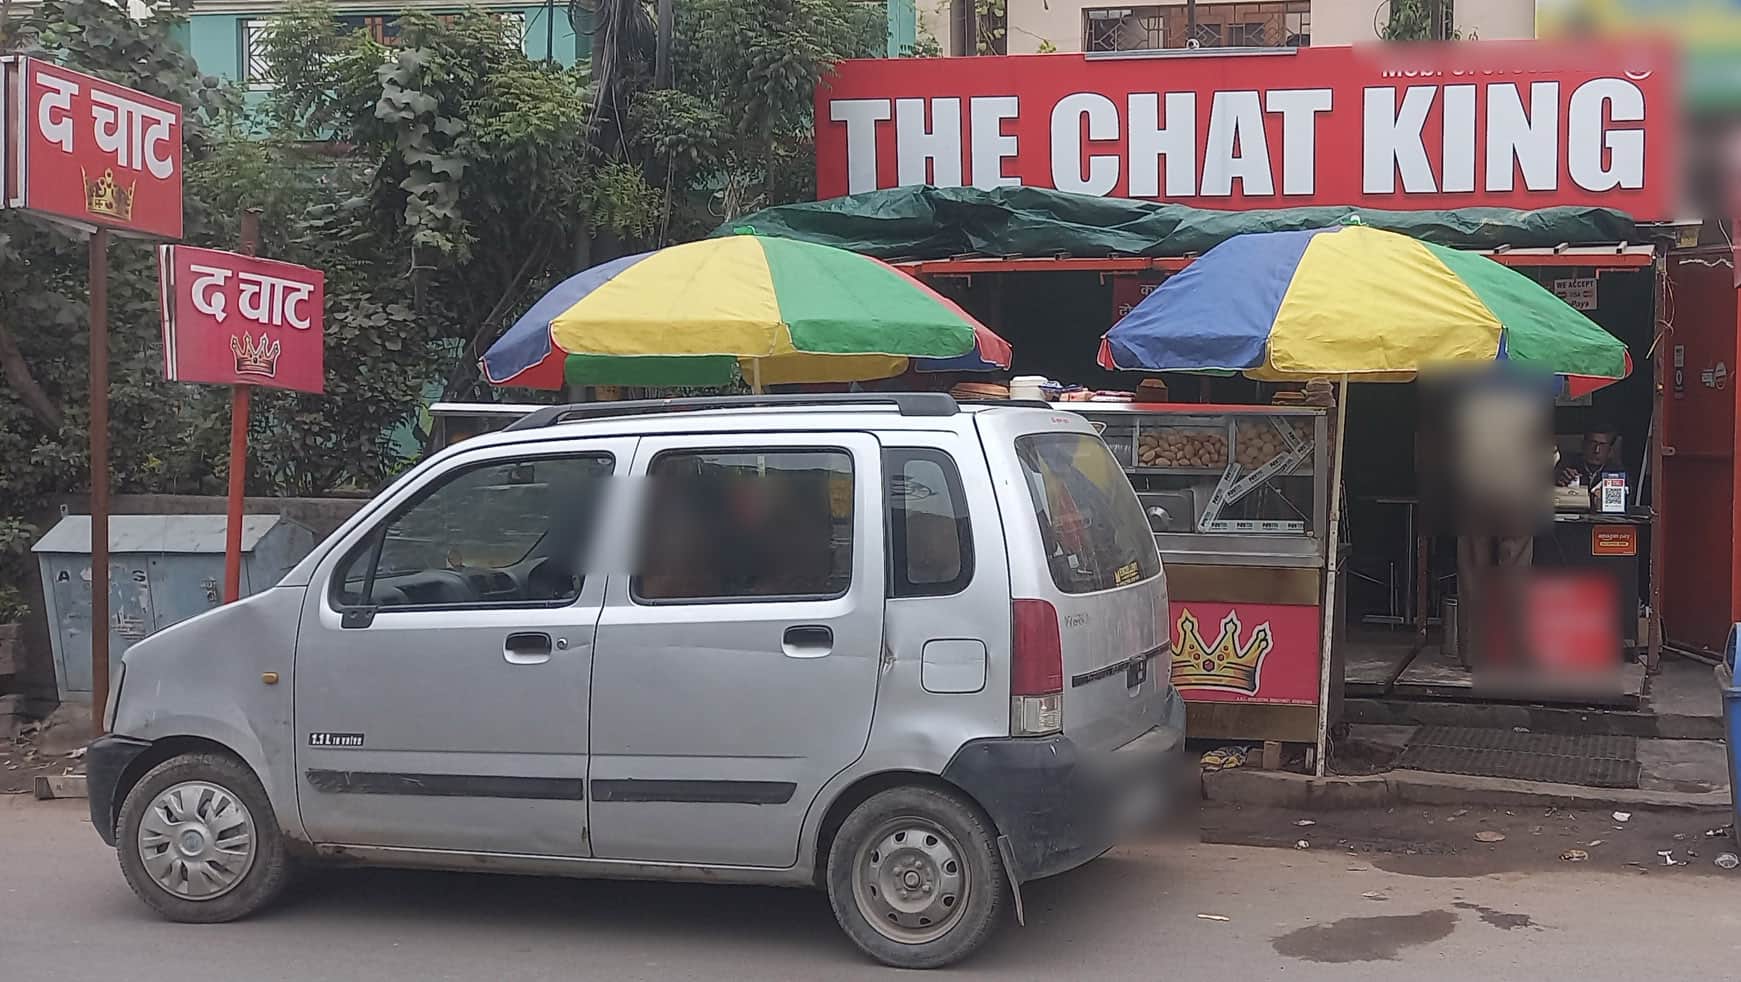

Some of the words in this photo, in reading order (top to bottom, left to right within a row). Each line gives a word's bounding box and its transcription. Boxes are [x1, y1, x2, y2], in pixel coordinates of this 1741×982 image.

[37, 72, 79, 153] द
[90, 89, 176, 179] चाट
[829, 96, 1023, 196] THE
[1050, 88, 1334, 197] CHAT
[1362, 77, 1646, 194] KING
[190, 264, 233, 323] द
[238, 271, 314, 330] चाट
[1568, 280, 1593, 288] ACCEPT
